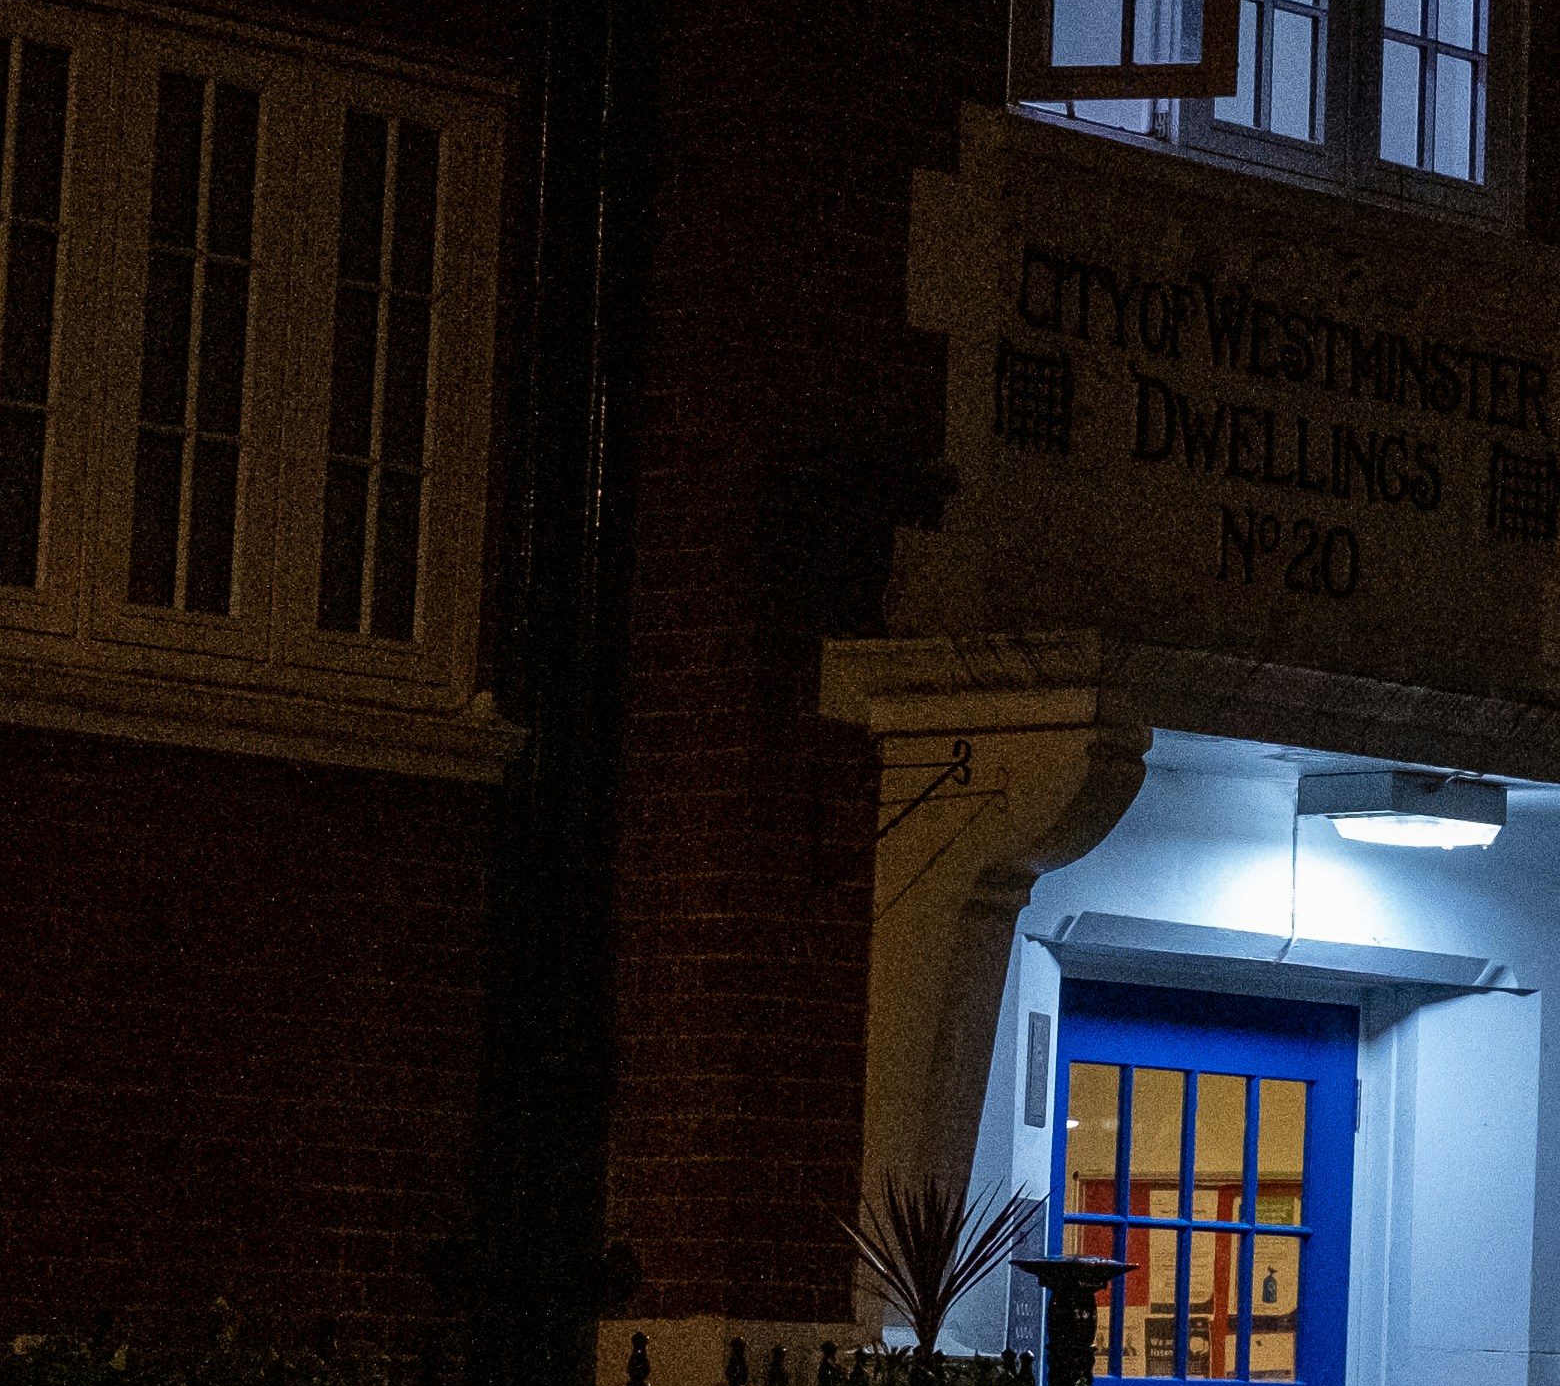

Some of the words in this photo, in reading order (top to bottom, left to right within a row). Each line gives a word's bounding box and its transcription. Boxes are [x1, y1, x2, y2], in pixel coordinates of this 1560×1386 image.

[1019, 248, 1133, 347] CITY
[1139, 281, 1193, 360] OF
[1195, 271, 1553, 436] WESTMINSTER
[1128, 360, 1440, 511] DWELLINGS
[1284, 520, 1360, 598] 20
